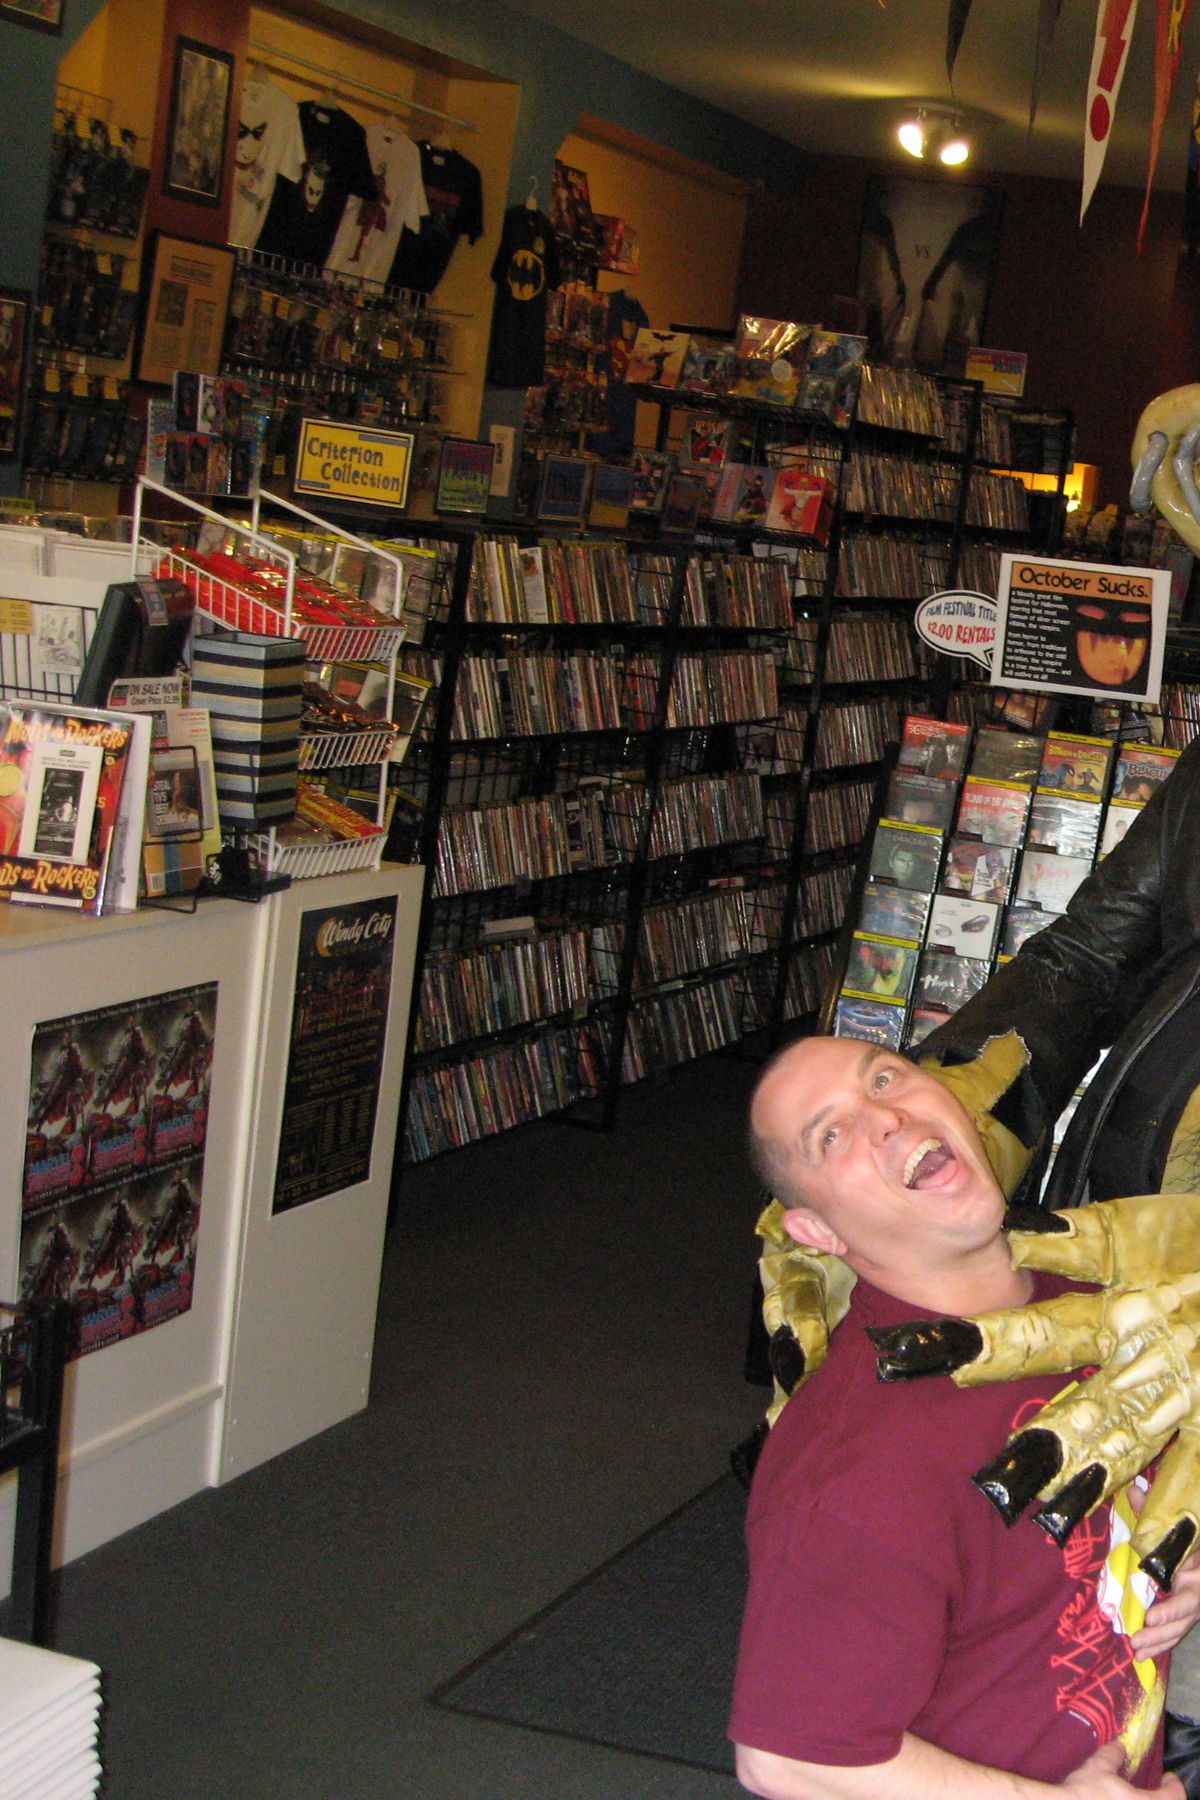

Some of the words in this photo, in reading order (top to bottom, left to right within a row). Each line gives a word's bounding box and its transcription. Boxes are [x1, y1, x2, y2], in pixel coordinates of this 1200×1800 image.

[307, 437, 383, 467] Criterion
[321, 462, 400, 492] Collection
[1019, 567, 1092, 591] October
[1098, 577, 1149, 598] Sucks.
[926, 603, 942, 616] FILM
[943, 601, 976, 617] FESTIVAL
[956, 624, 996, 644] RENTALS
[129, 684, 140, 695] ON
[141, 683, 160, 695] SALE
[162, 682, 179, 694] NOW
[131, 697, 147, 706] Cover
[149, 696, 162, 705] Price
[64, 718, 129, 750] ROCKERS
[32, 860, 100, 893] ROCKERS
[323, 918, 365, 947] Windy
[364, 912, 392, 938] City
